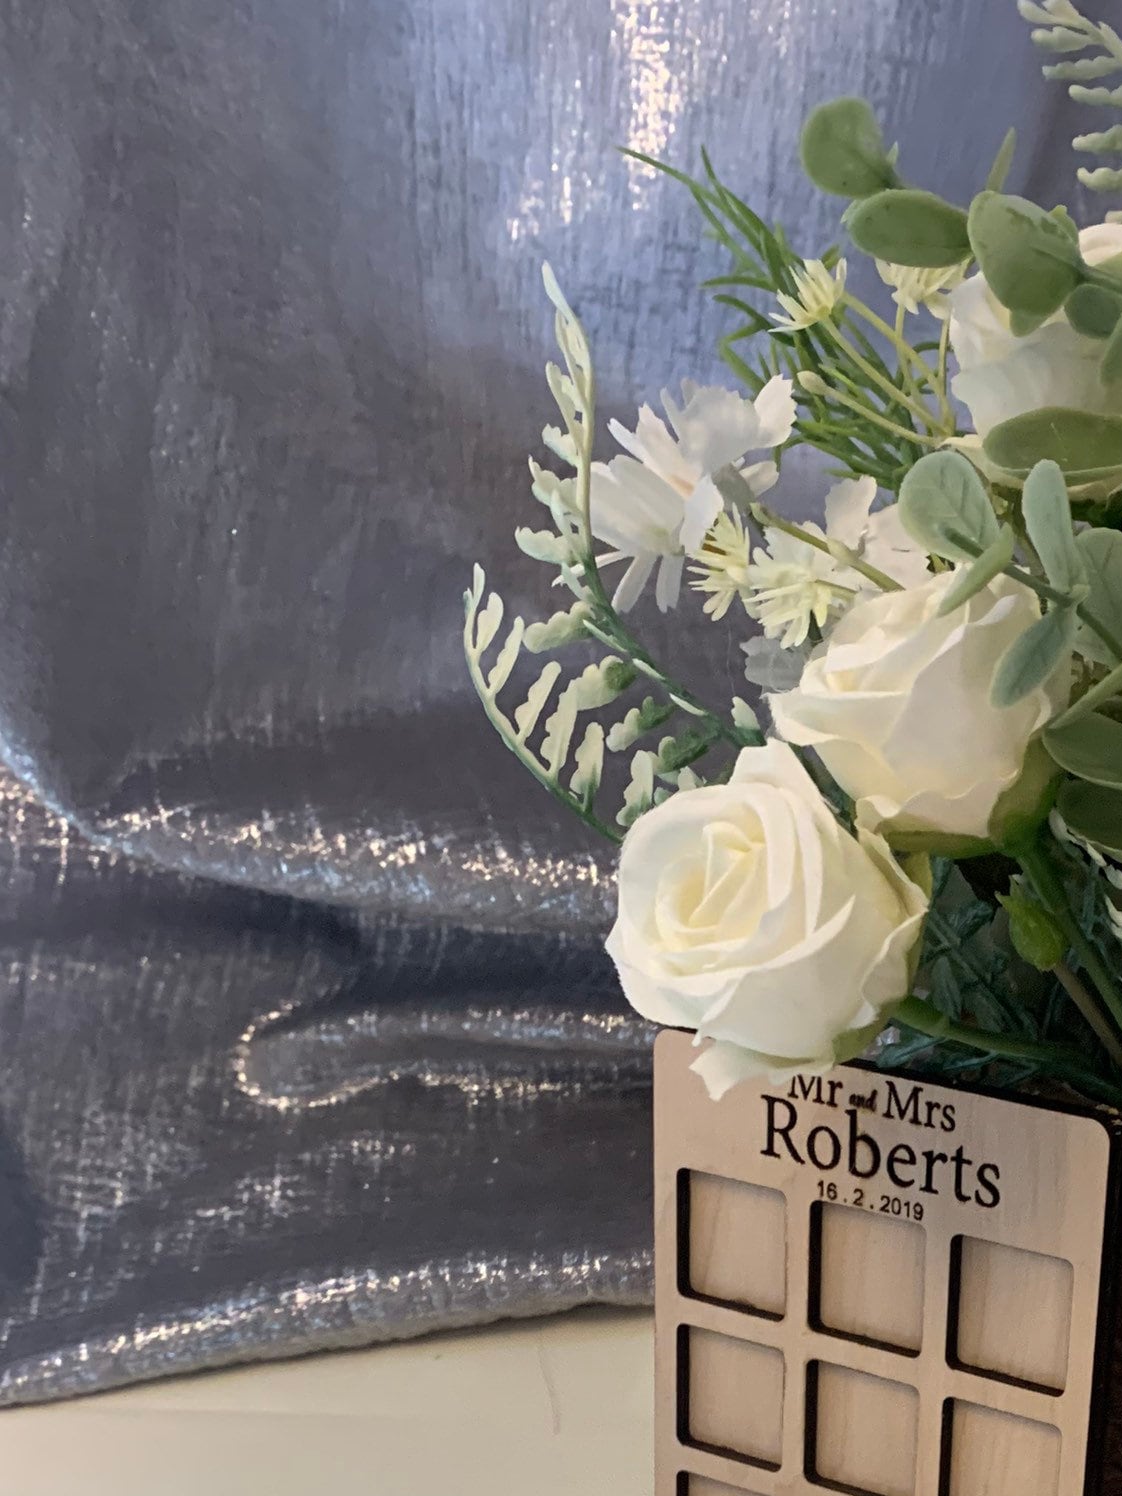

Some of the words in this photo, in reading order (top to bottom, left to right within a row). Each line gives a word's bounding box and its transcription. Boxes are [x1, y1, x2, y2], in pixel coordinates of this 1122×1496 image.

[789, 1074, 843, 1108] Mr
[882, 1080, 956, 1132] Mrs
[760, 1094, 1001, 1208] Roberts
